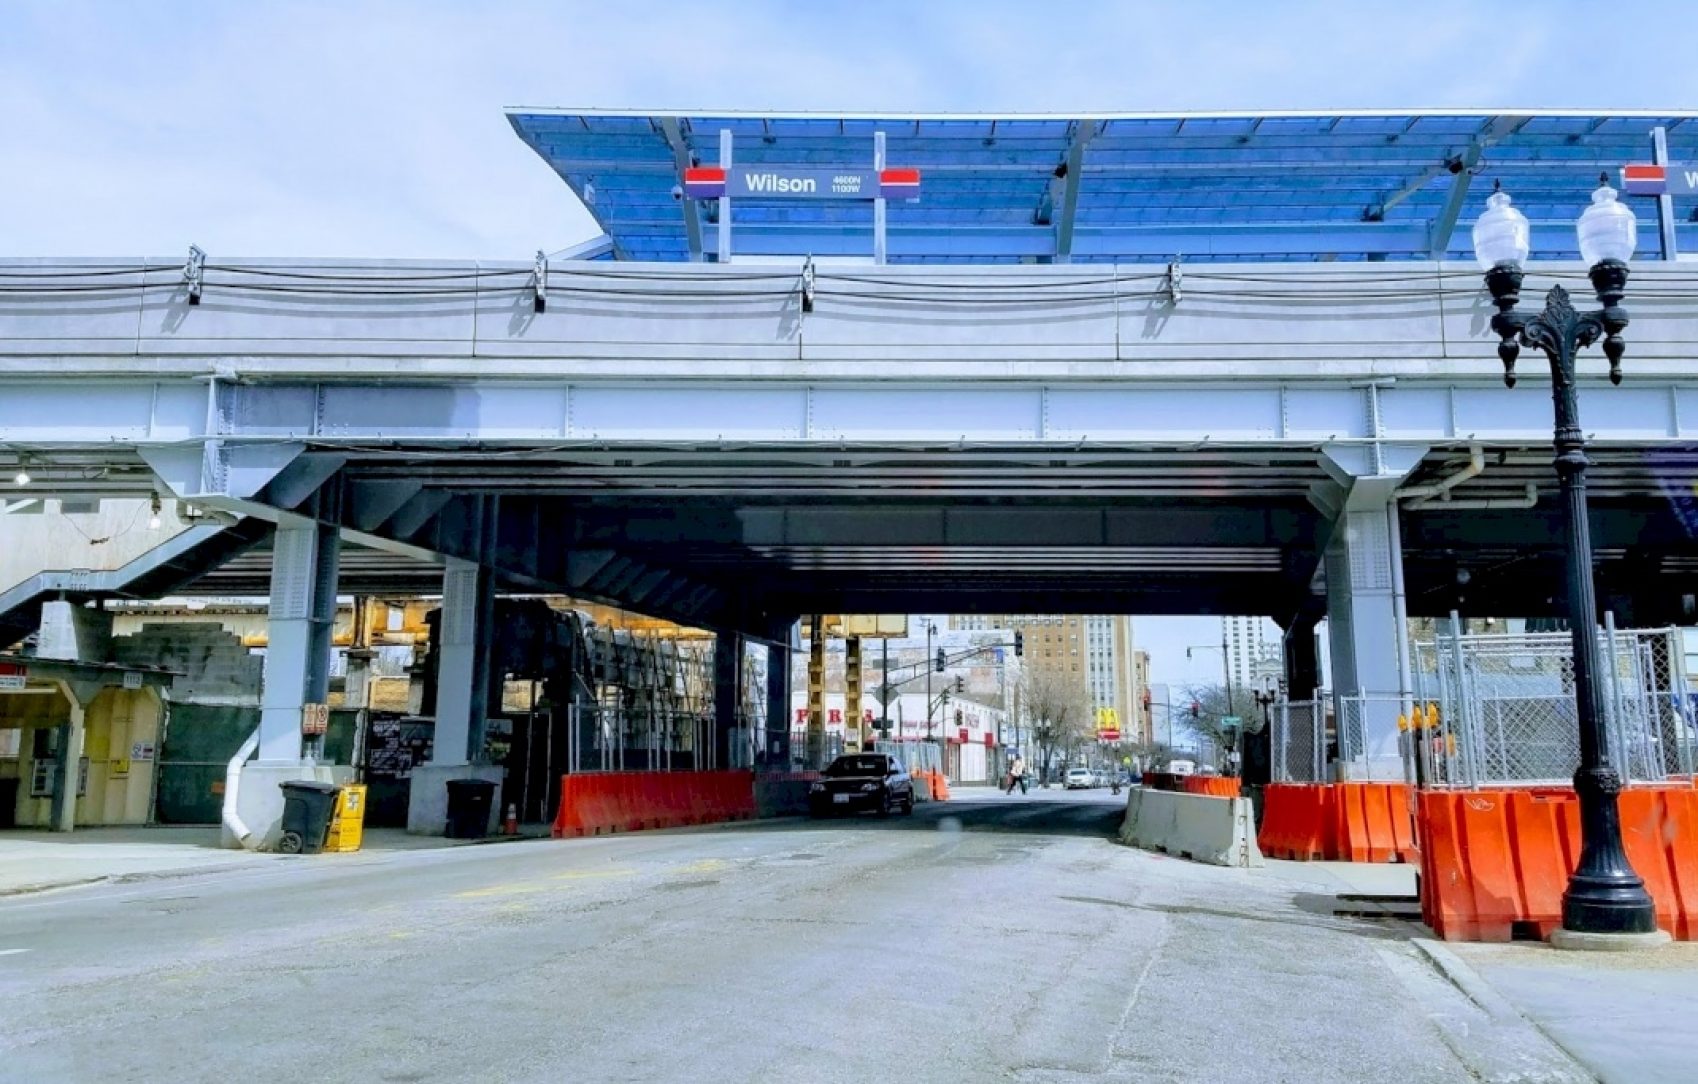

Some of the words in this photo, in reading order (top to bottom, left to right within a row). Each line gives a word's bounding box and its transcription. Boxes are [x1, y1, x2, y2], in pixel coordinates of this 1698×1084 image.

[745, 173, 816, 193] Wilson
[833, 175, 861, 184] 4600N
[832, 185, 861, 193] 1100W
